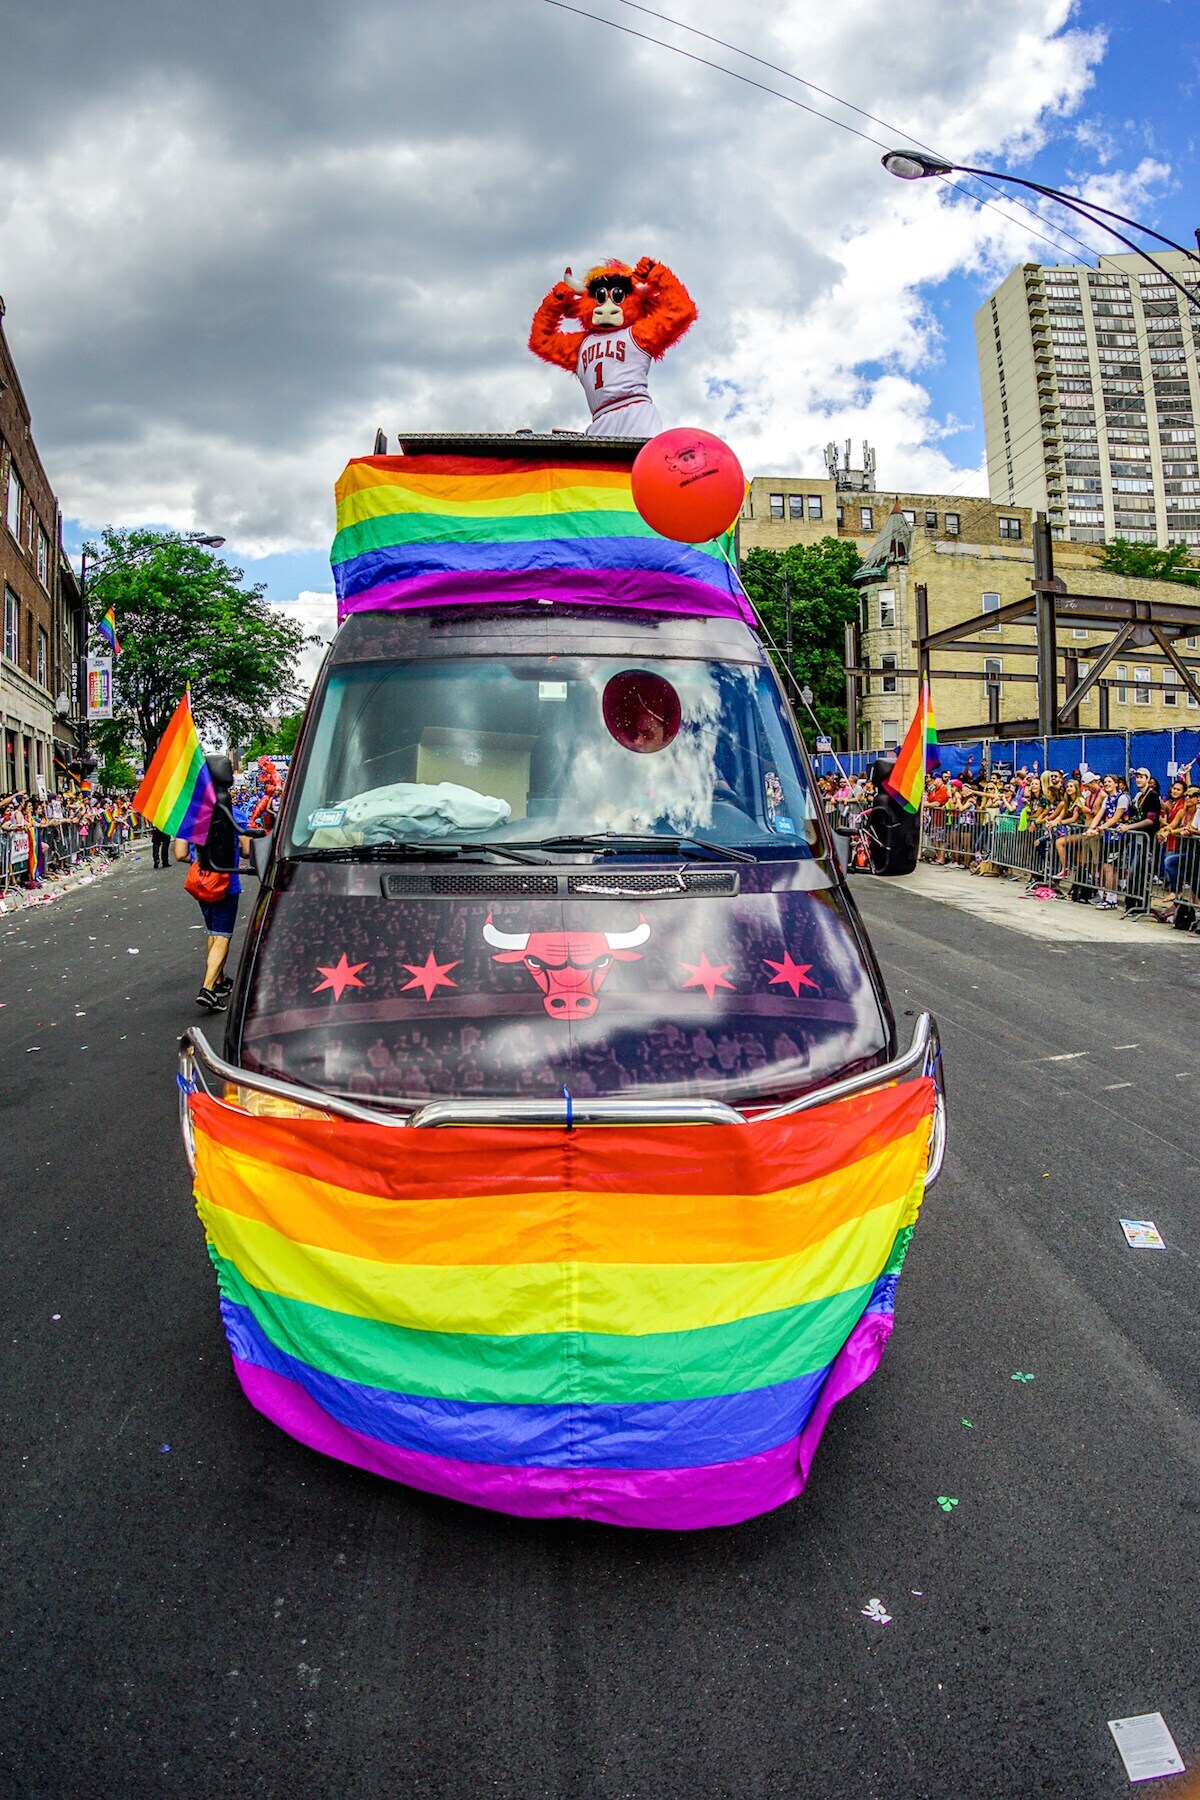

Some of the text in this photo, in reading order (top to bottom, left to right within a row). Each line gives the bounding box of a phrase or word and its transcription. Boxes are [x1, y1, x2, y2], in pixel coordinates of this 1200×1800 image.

[582, 340, 626, 374] BULLS
[594, 361, 604, 390] 1
[93, 675, 101, 702] PRIDE
